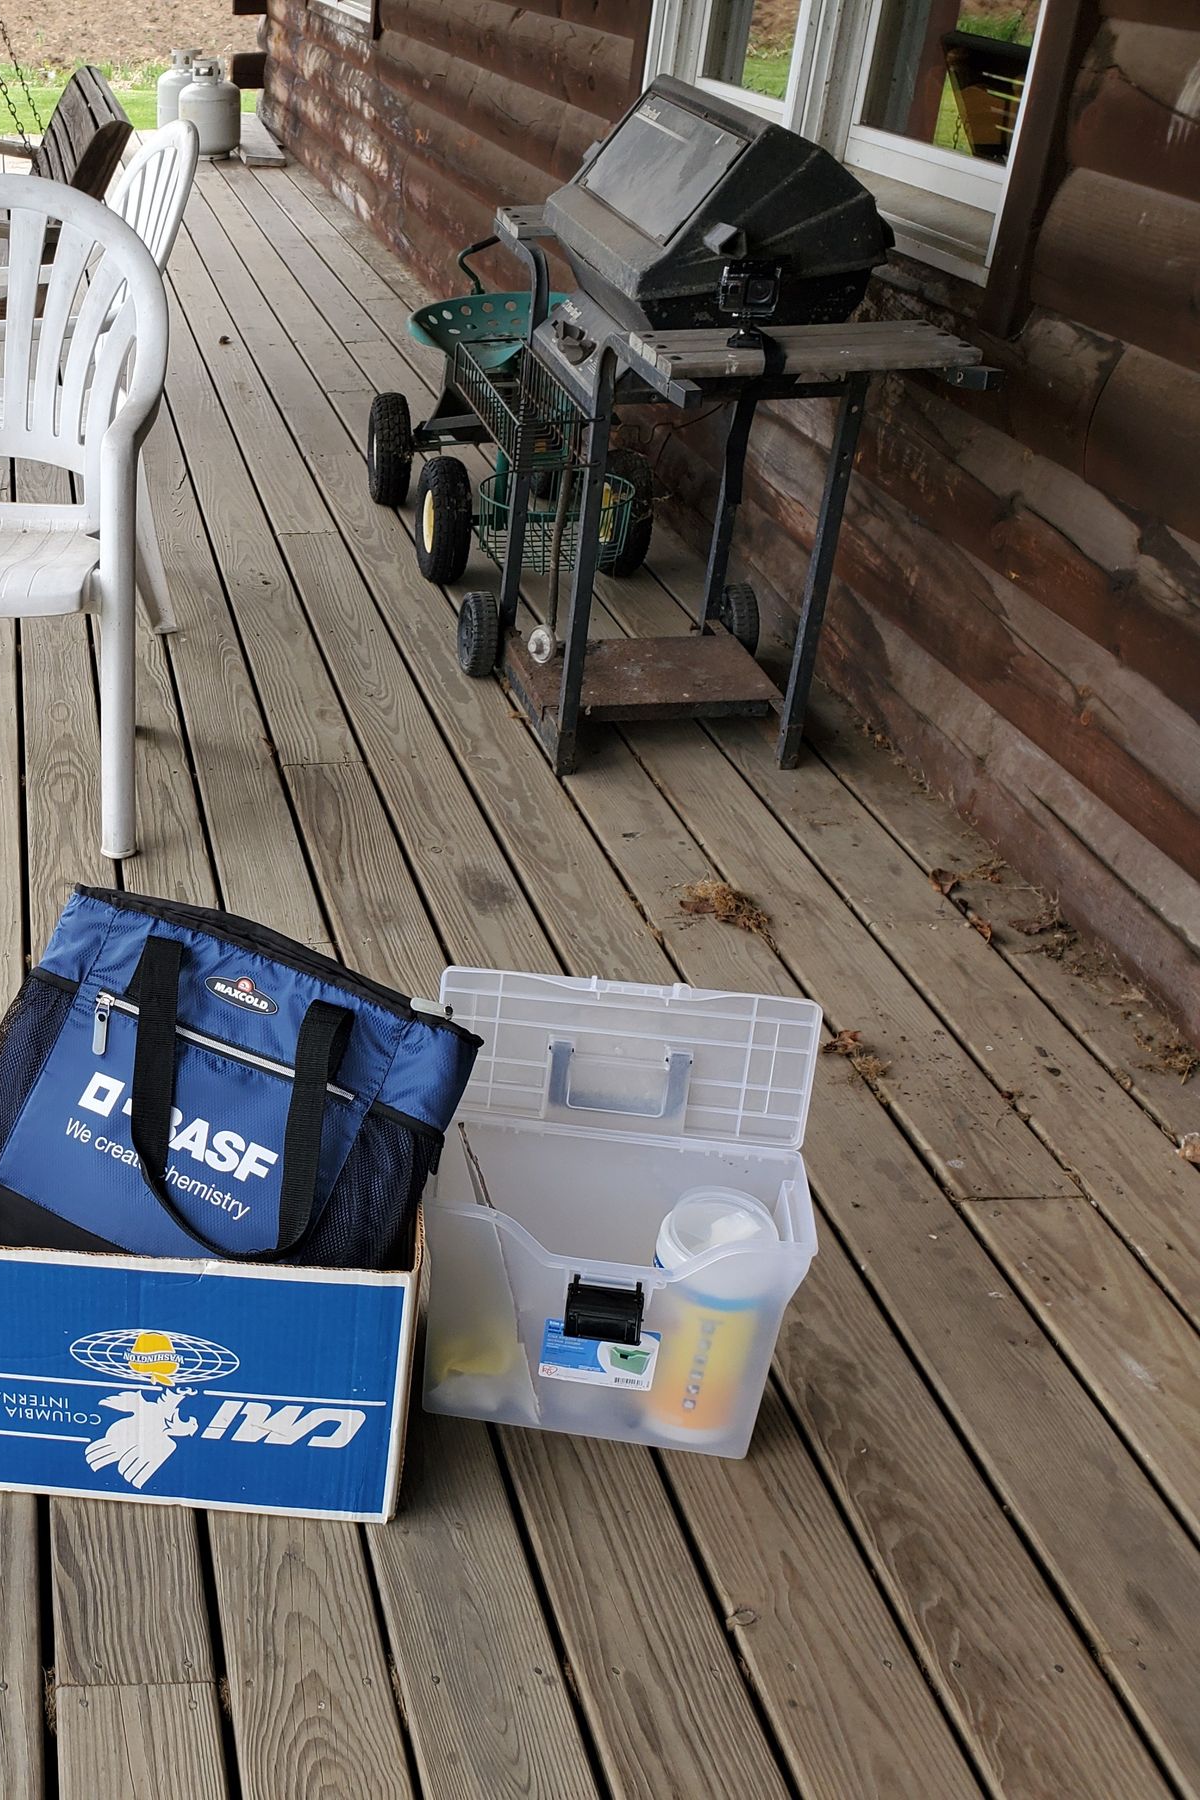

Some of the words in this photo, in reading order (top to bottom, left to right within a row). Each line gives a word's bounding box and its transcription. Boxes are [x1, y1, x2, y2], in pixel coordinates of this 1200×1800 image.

[213, 981, 269, 1010] MAXCOLD
[65, 1117, 92, 1144] We
[94, 1135, 144, 1170] creat
[123, 1351, 185, 1365] WASHINGTON
[4, 1405, 102, 1426] COLUMBIA
